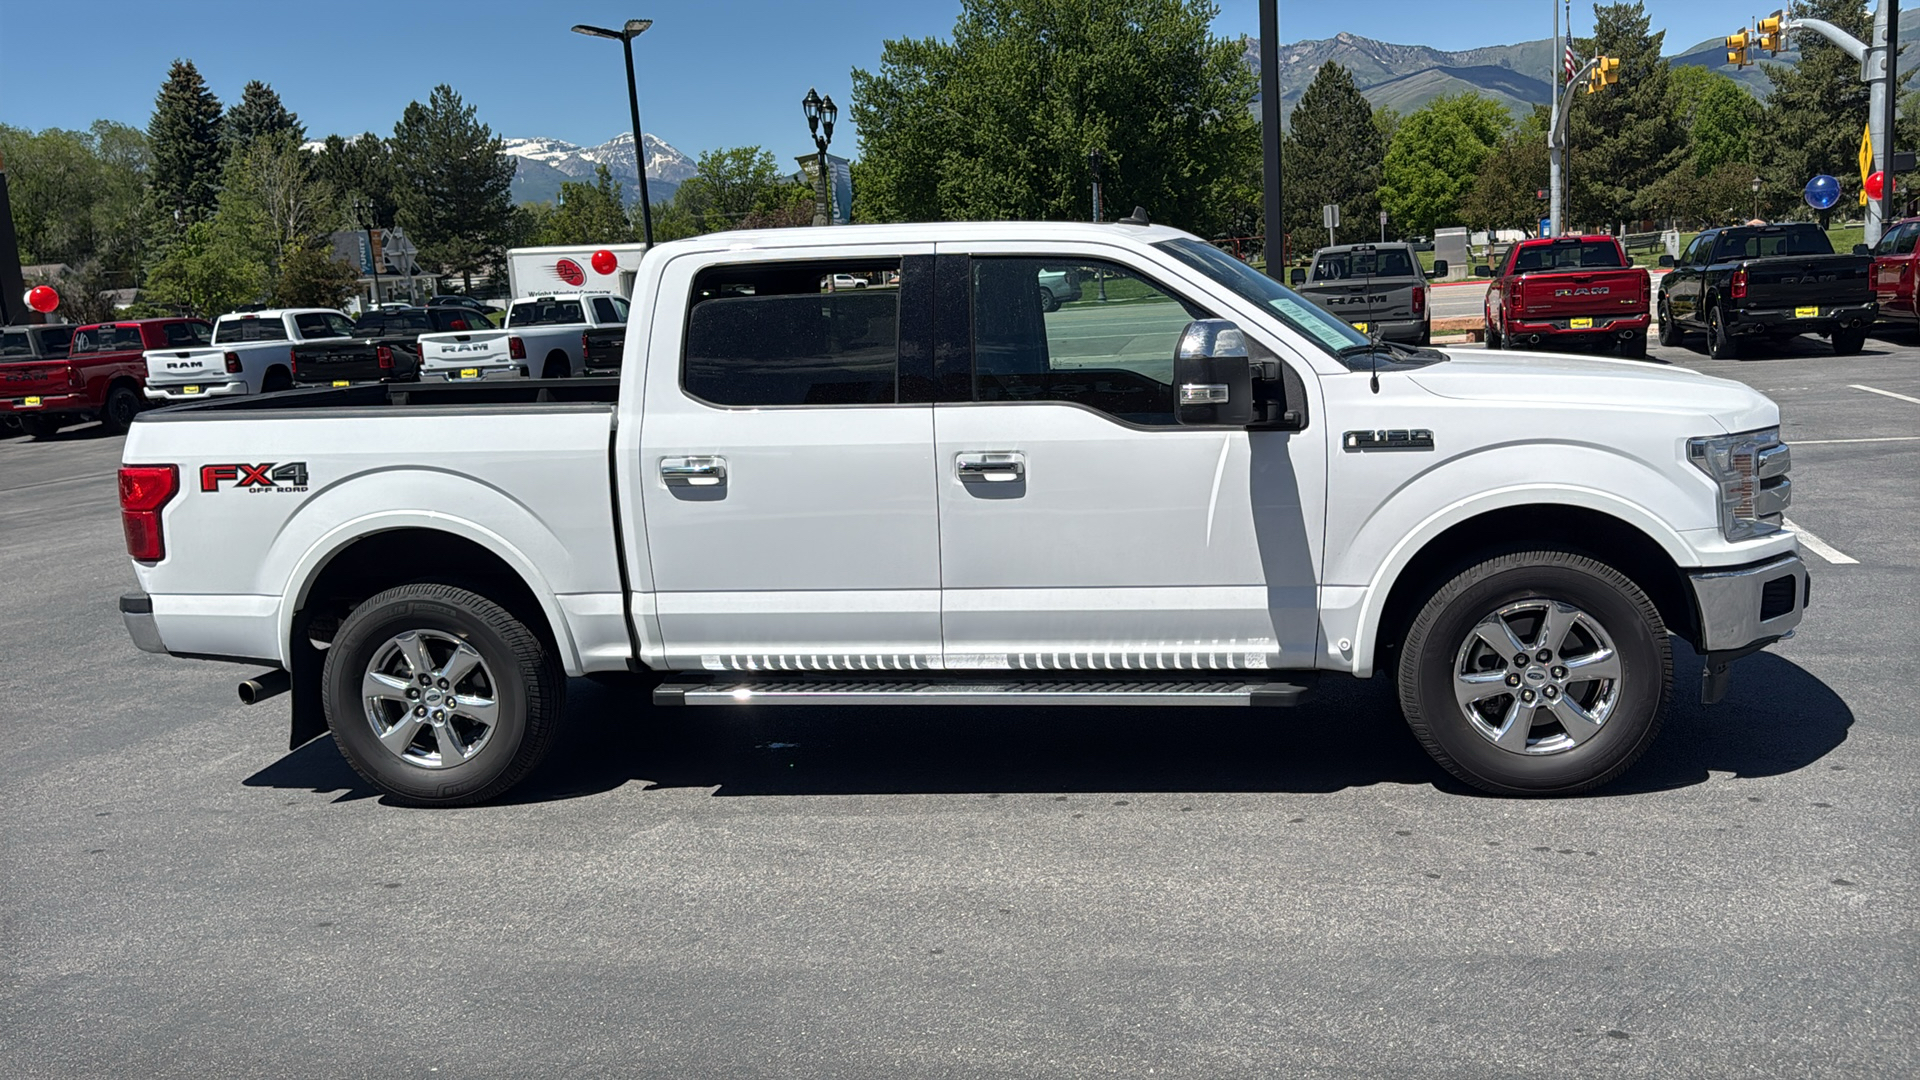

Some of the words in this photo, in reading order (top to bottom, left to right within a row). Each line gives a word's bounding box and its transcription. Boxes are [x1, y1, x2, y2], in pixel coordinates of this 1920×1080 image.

[359, 236, 367, 264] UNITY
[1780, 274, 1837, 284] RAM
[1555, 287, 1609, 296] RAM
[1326, 295, 1387, 305] RAM
[441, 343, 489, 353] RAM
[5, 373, 48, 382] RAM
[200, 462, 309, 492] FX4
